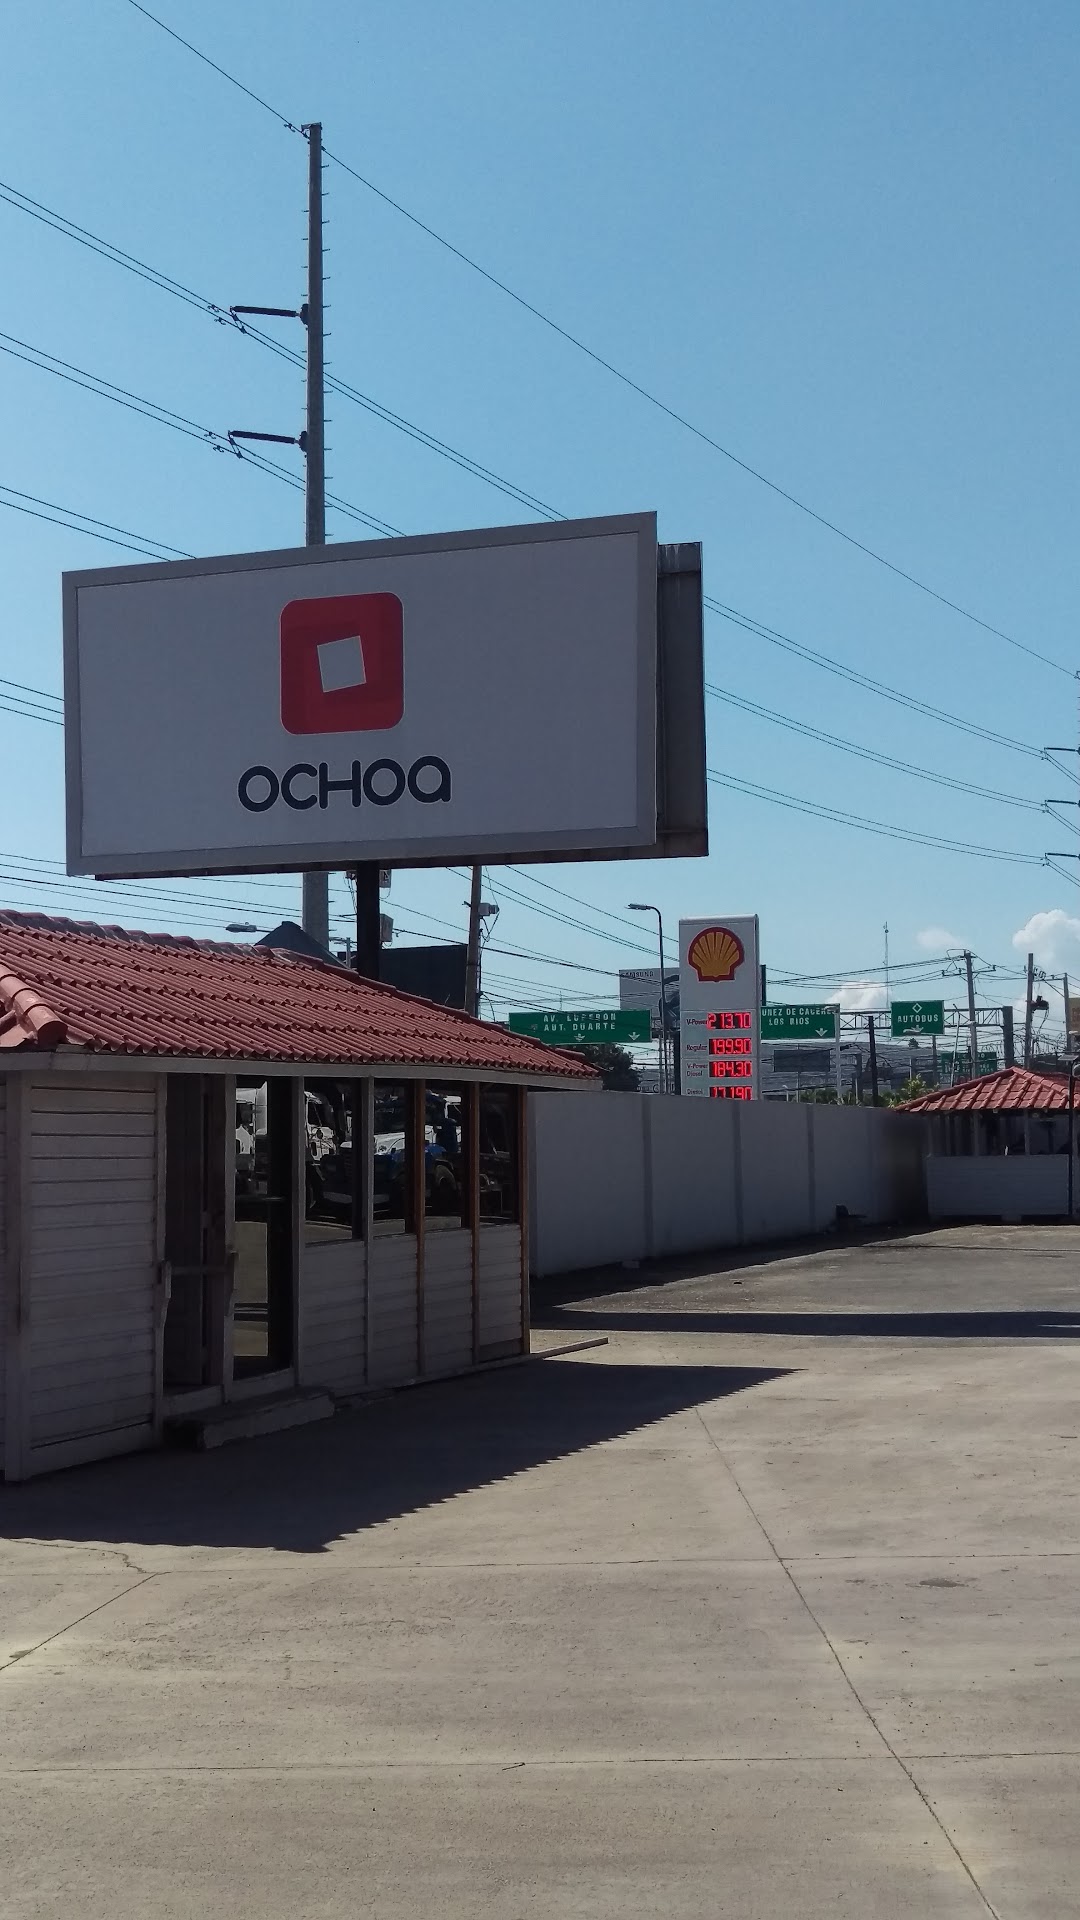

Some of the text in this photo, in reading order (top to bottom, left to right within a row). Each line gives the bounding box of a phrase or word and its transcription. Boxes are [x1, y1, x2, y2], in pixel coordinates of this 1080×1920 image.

[761, 1007, 834, 1017] UNEZ DE CACERE
[769, 1017, 810, 1026] LOS RIOS
[897, 1013, 939, 1023] AUTOBUS
[572, 1022, 616, 1031] DUARTE
